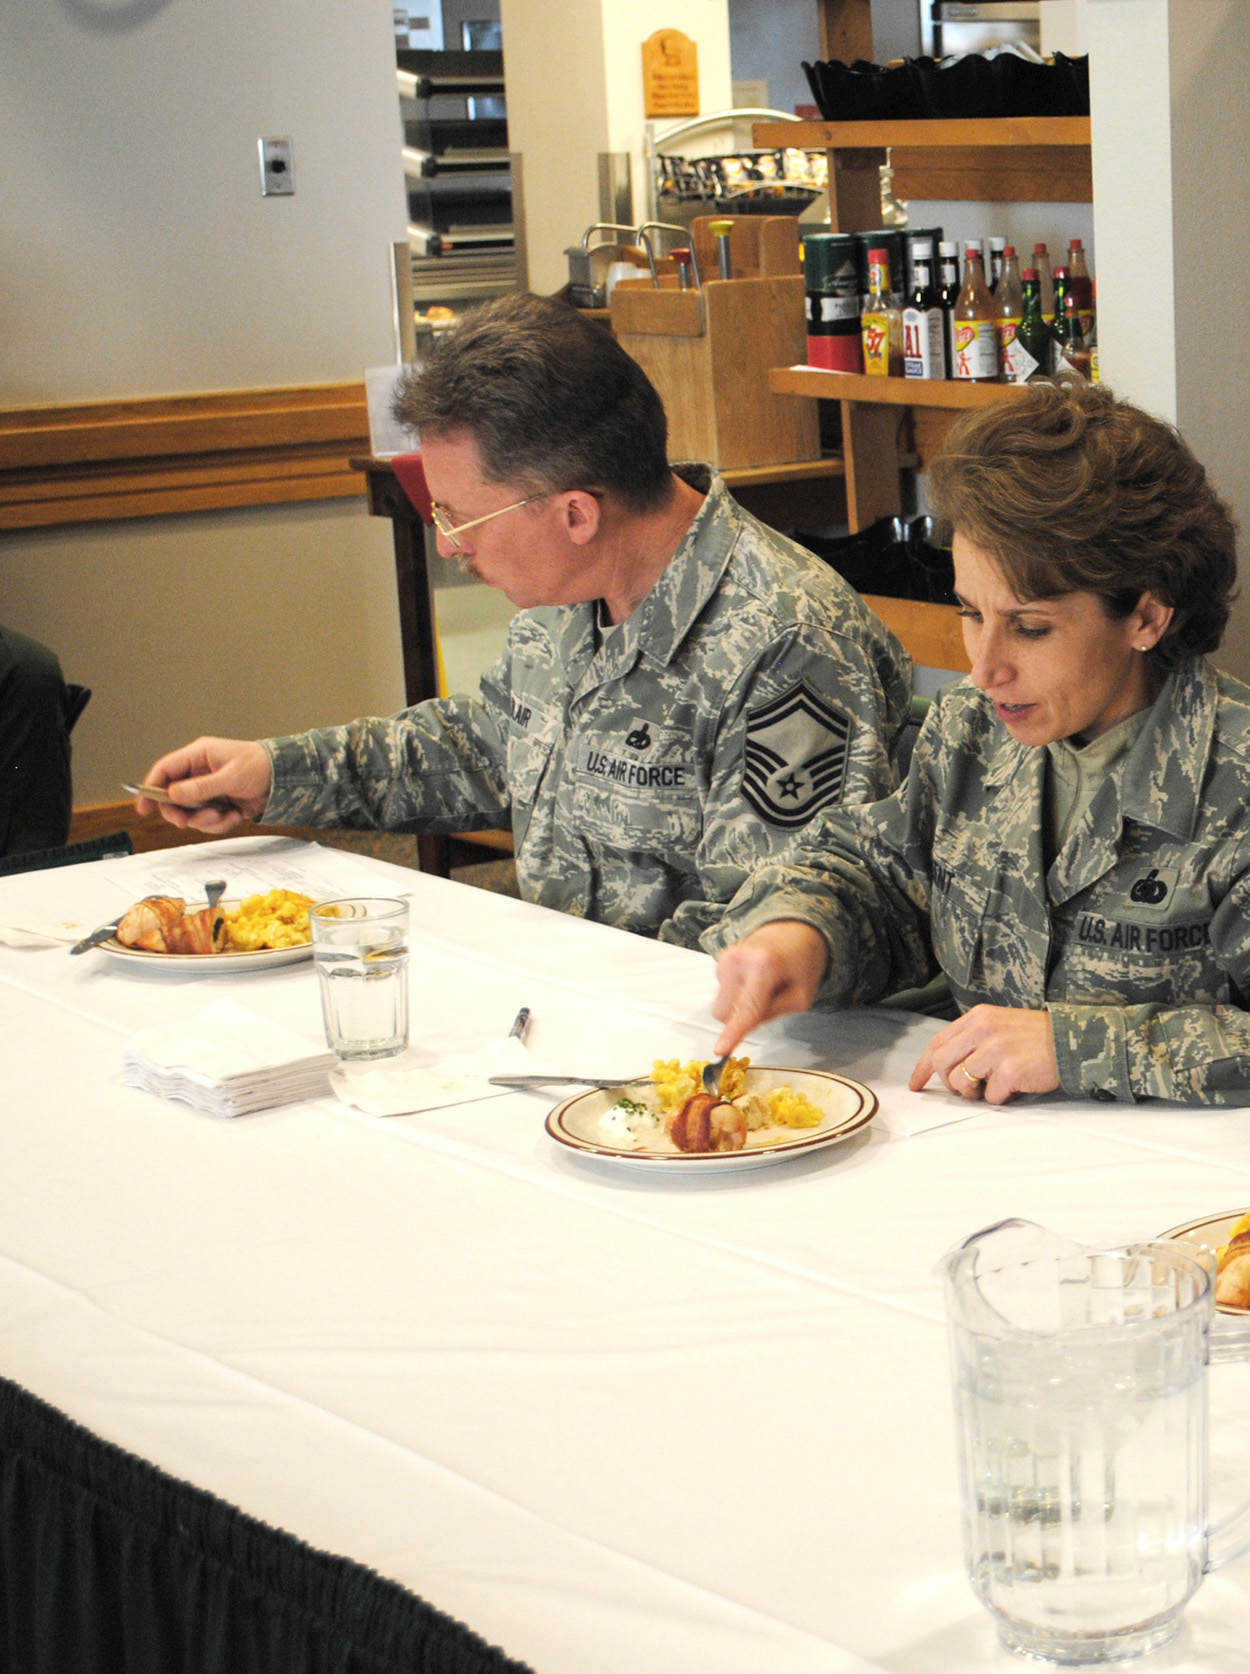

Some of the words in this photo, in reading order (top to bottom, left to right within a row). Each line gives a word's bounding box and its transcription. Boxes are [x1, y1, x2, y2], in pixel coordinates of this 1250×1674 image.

[607, 759, 628, 782] AIR
[628, 765, 686, 787] FORCE
[1111, 922, 1142, 951] AIR
